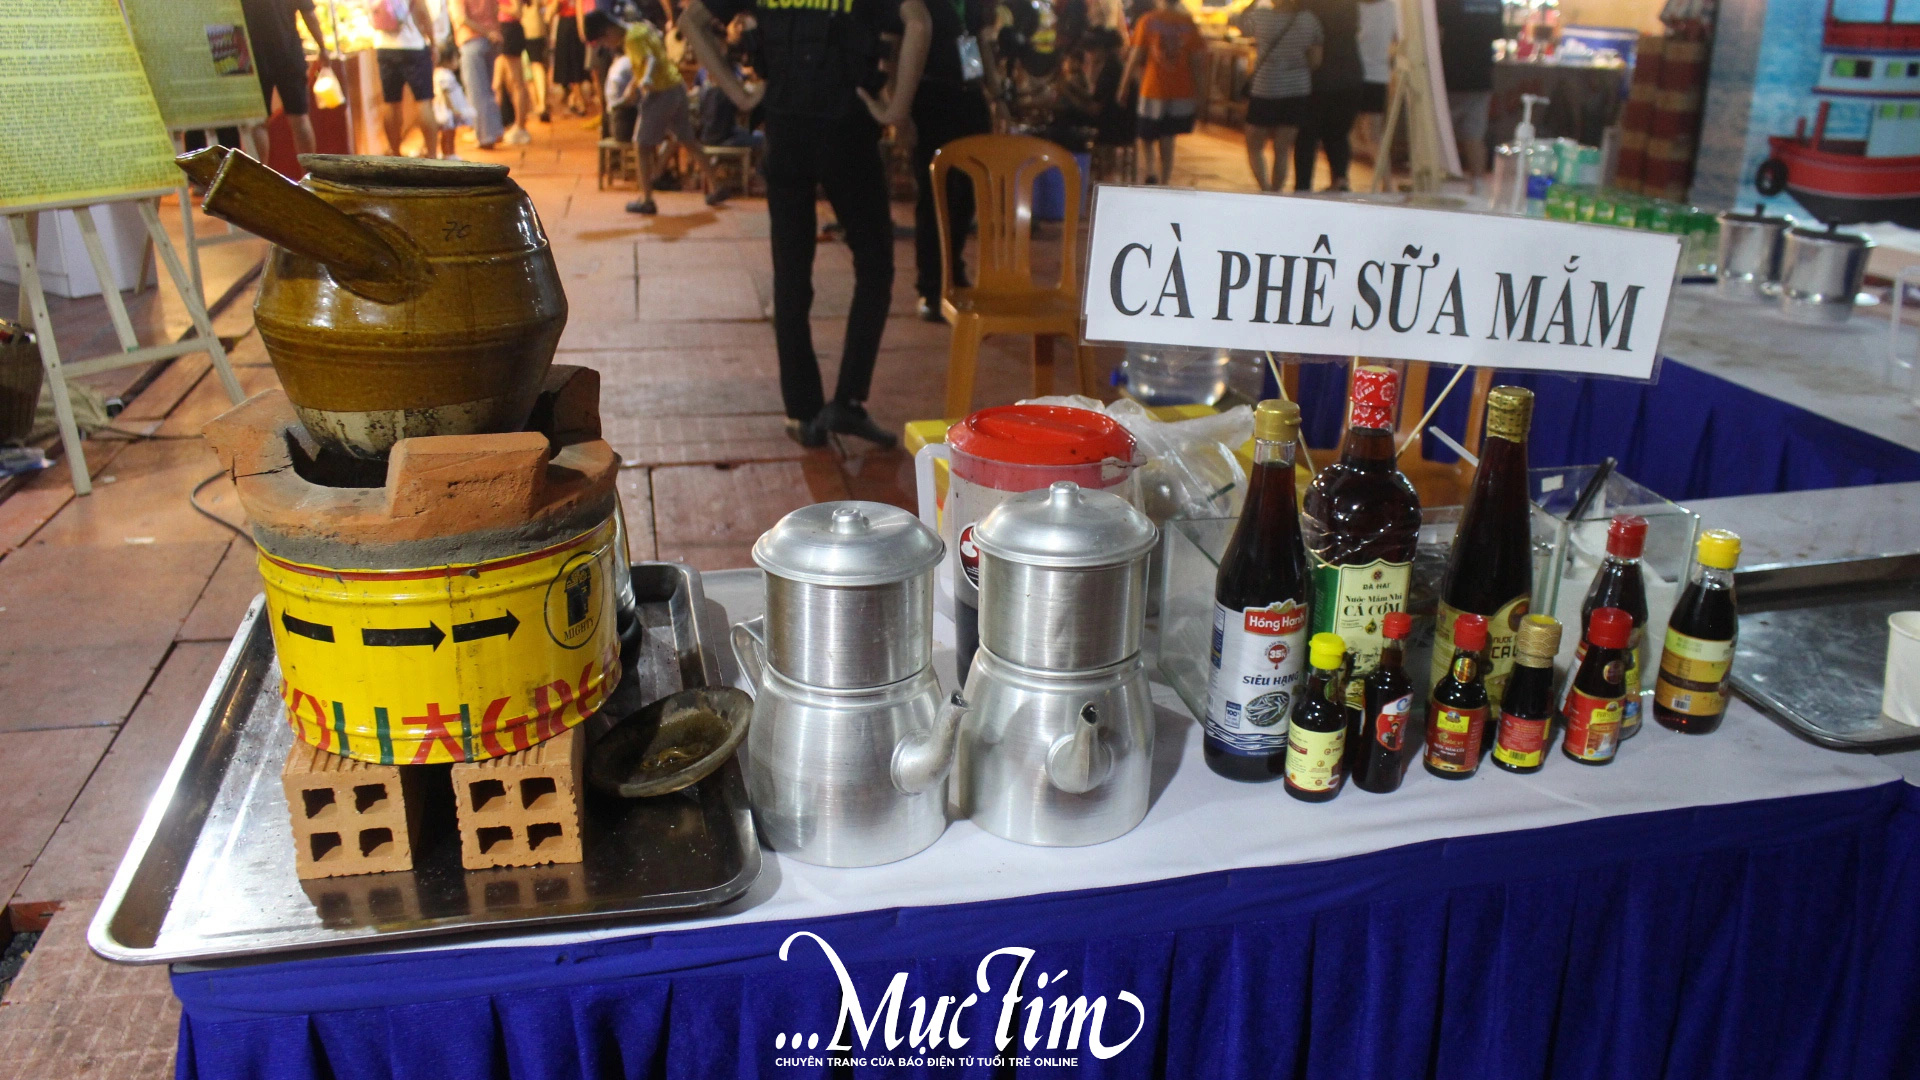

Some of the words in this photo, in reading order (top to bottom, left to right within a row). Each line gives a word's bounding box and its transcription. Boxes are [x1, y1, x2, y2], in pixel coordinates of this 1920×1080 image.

[1110, 222, 1194, 319] CÀ
[1212, 234, 1337, 328] PHÊ
[1351, 244, 1468, 337] SỮA
[1486, 254, 1645, 351] MẮM
[564, 618, 595, 642] MIGHTY
[1249, 614, 1281, 632] Hồng
[1242, 674, 1271, 686] SIÊU
